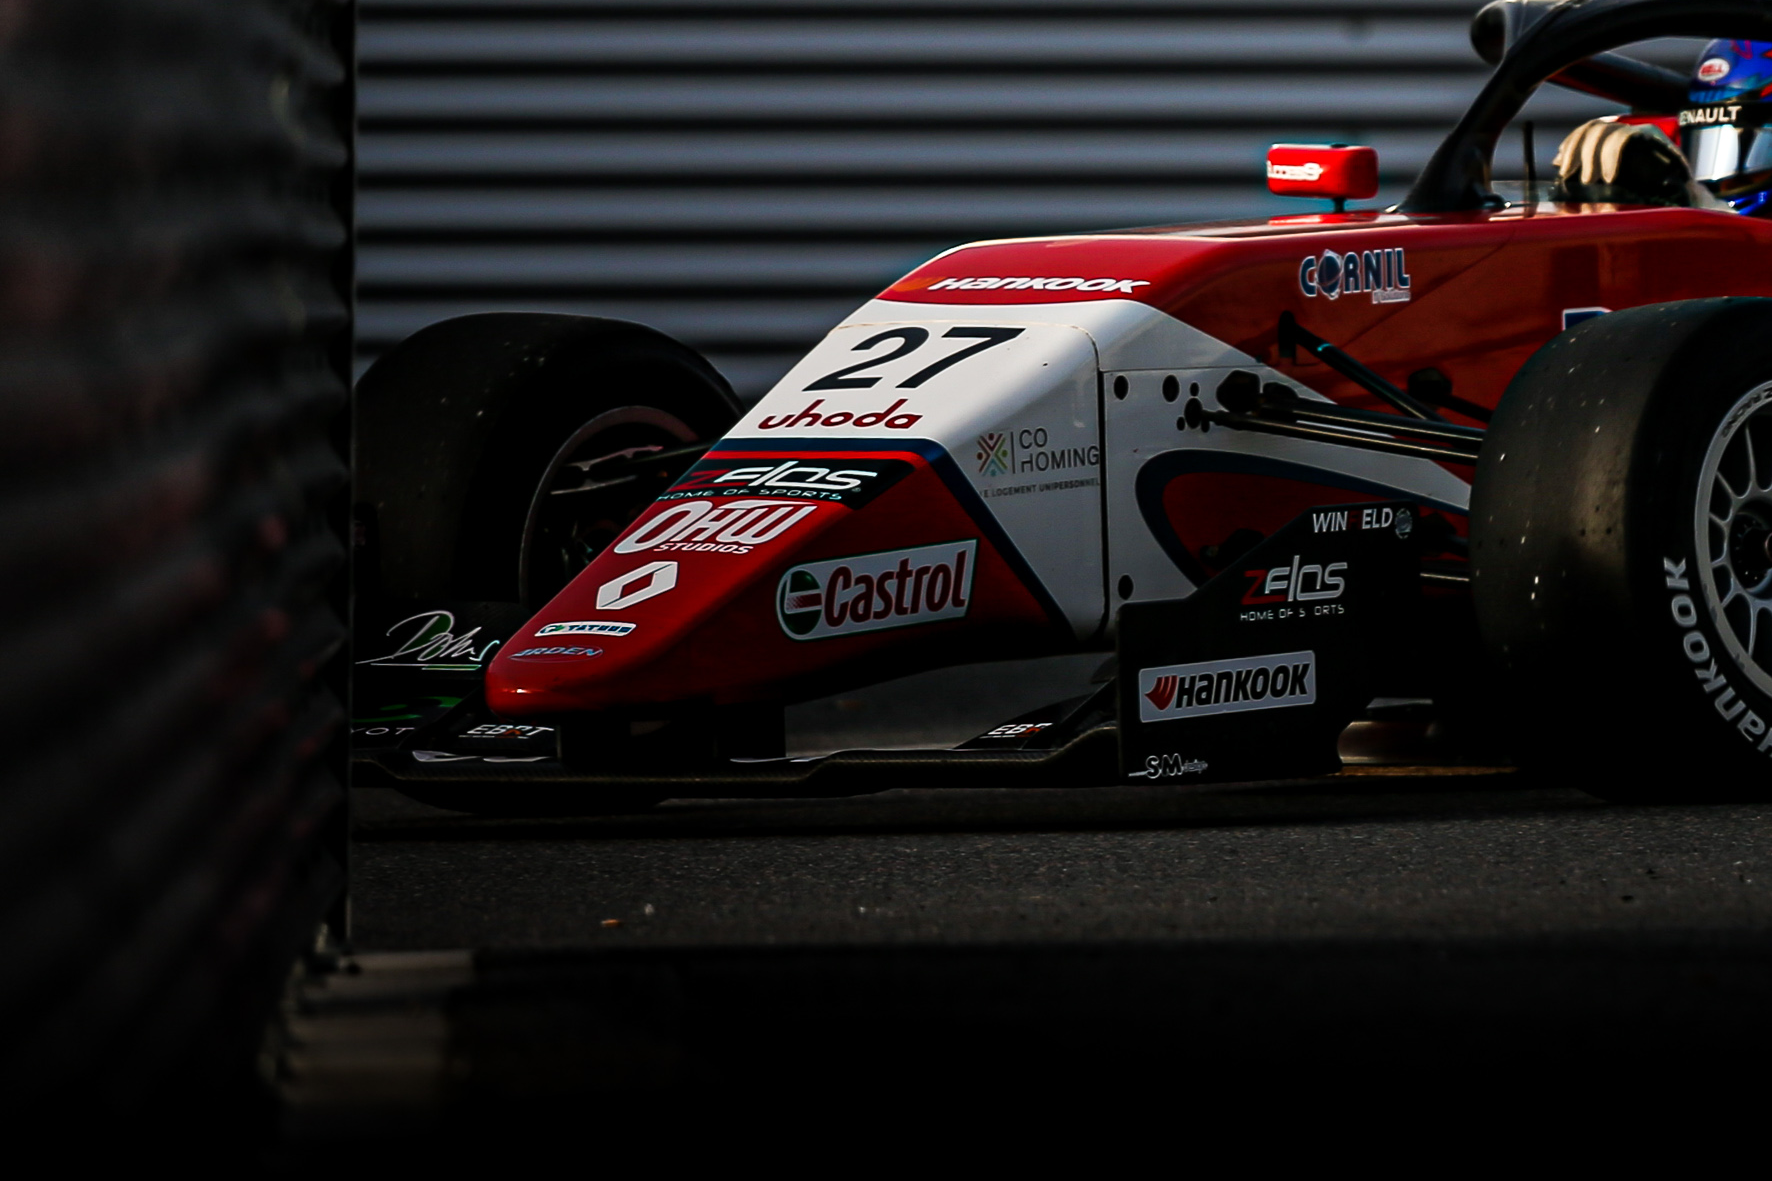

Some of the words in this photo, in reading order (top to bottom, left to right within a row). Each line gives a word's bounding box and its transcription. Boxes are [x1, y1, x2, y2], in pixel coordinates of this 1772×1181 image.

[1677, 105, 1742, 126] ENAULT
[1299, 248, 1411, 301] CORNIL
[801, 326, 1027, 393] 27
[757, 398, 924, 431] uhoda
[1019, 427, 1048, 450] CO
[1021, 445, 1100, 473] HOMING
[655, 488, 714, 501] HOME
[722, 488, 750, 496] OF
[758, 487, 843, 501] SPORTS
[653, 541, 755, 555] STUDIOS
[824, 550, 967, 629] Castrol
[1240, 609, 1274, 622] HOME
[1279, 607, 1294, 619] OF
[1298, 604, 1345, 618] SORTS
